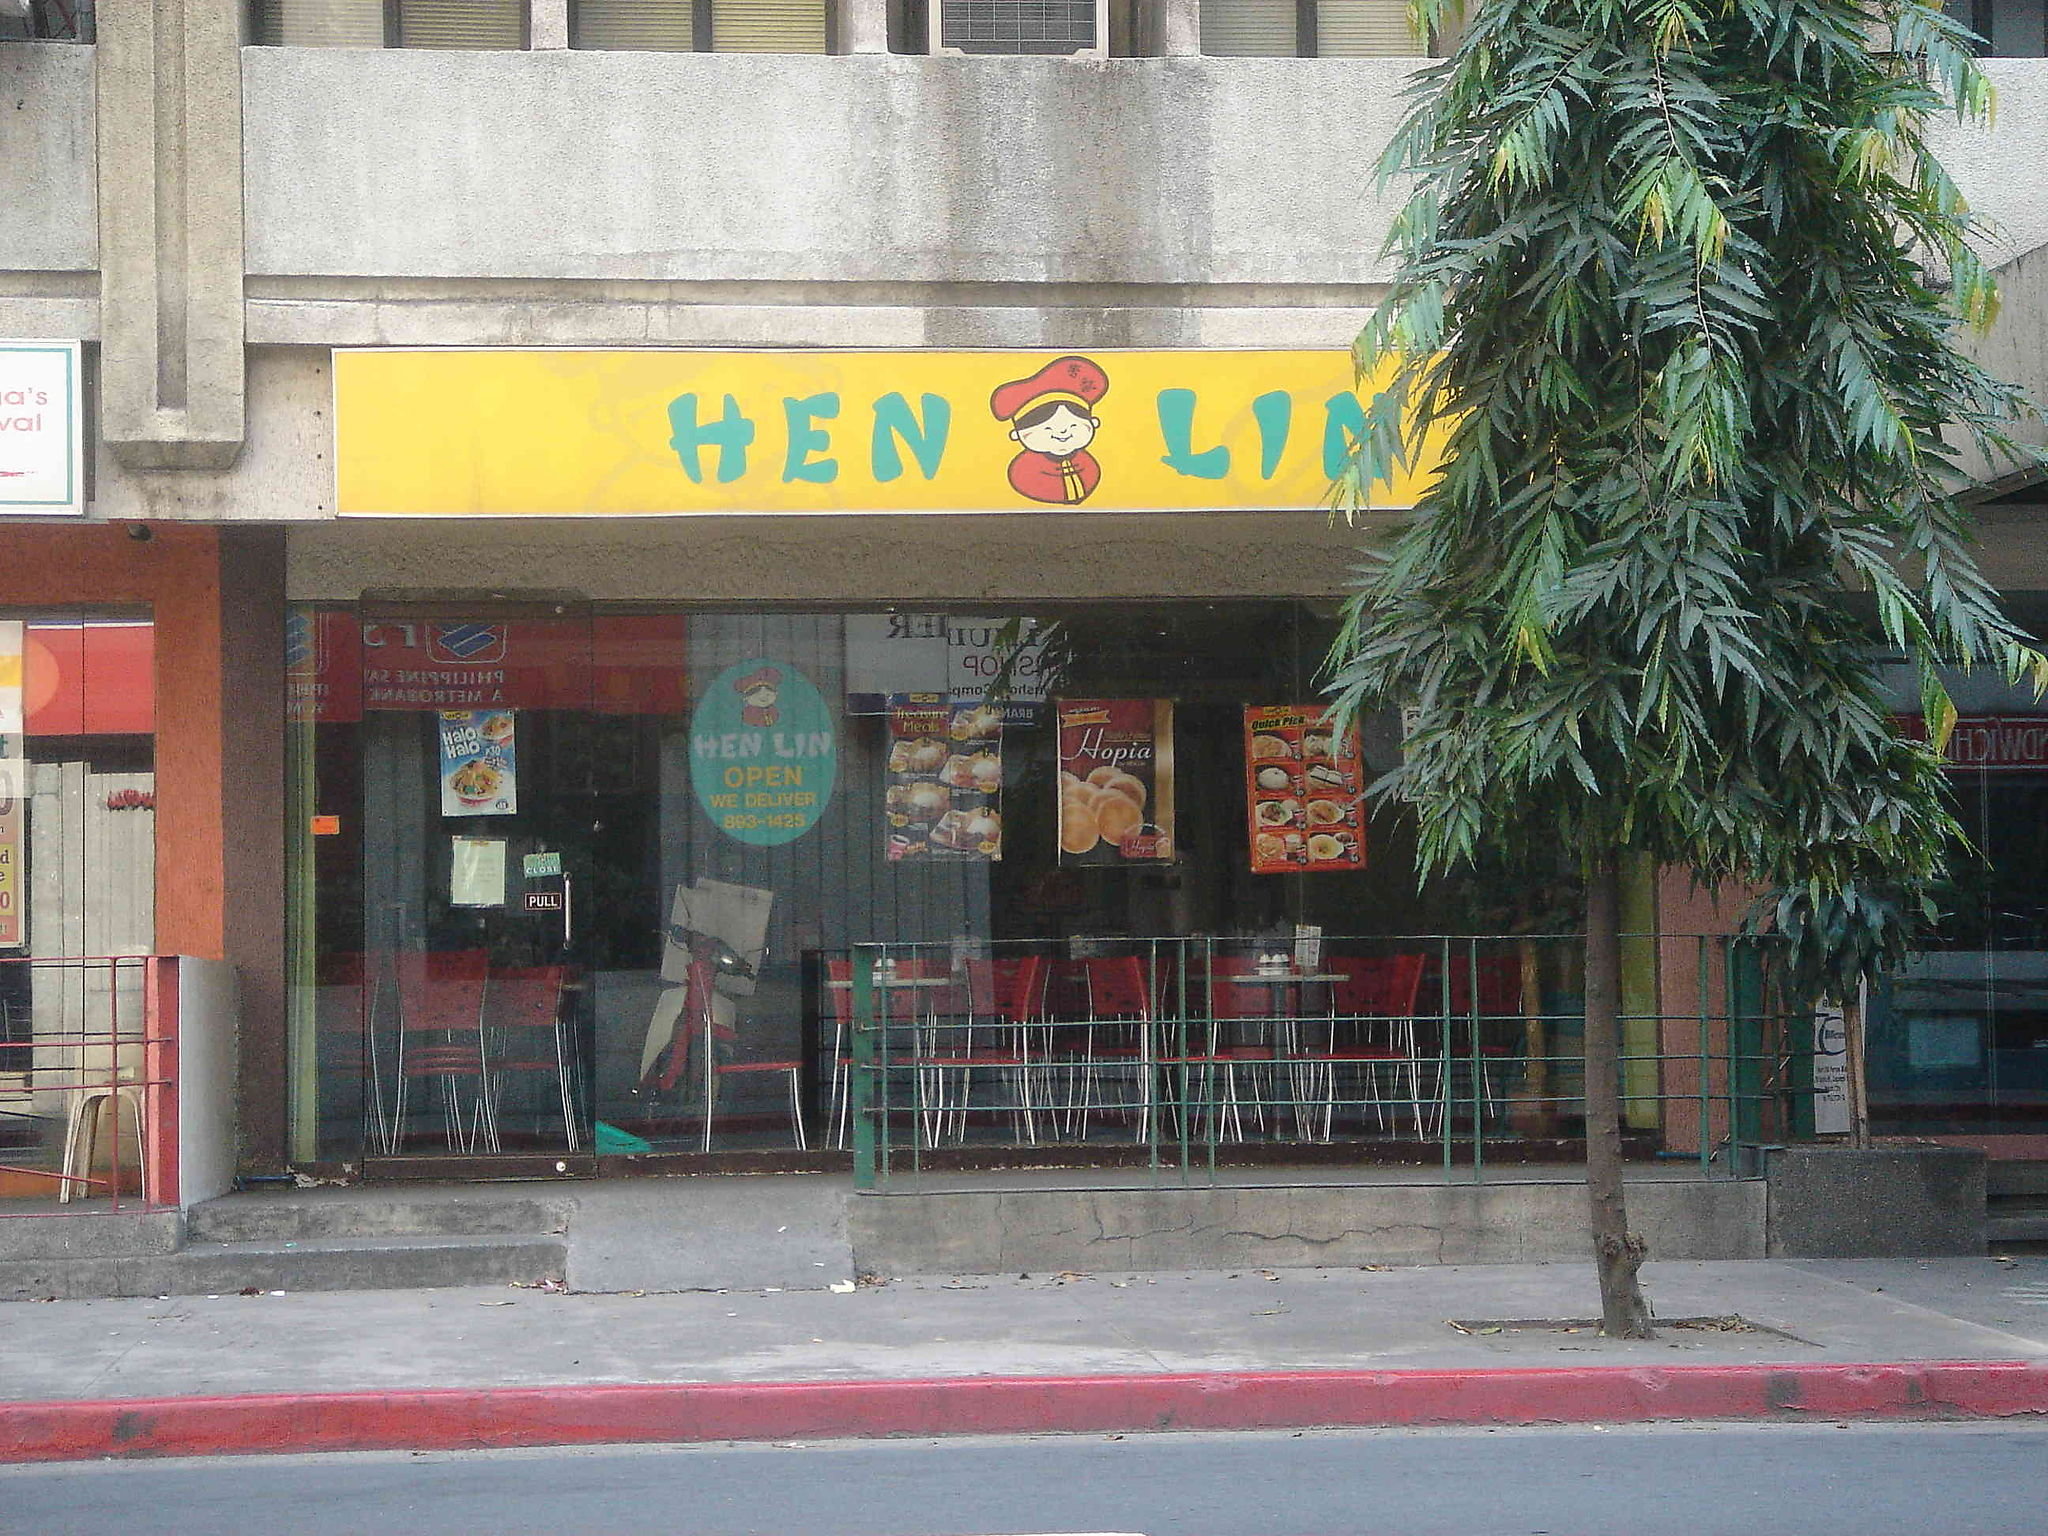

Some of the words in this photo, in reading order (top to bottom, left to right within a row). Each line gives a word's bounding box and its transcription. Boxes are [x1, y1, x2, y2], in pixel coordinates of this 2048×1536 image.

[667, 391, 951, 484] HEN
[442, 727, 477, 746] Halo
[694, 733, 763, 759] HEN
[773, 732, 832, 758] LIN
[447, 741, 480, 759] Halo
[1060, 728, 1151, 768] Hopia
[723, 766, 804, 788] OPEN
[710, 793, 738, 808] WE
[745, 791, 817, 808] DELIVER
[529, 895, 558, 907] PULL
